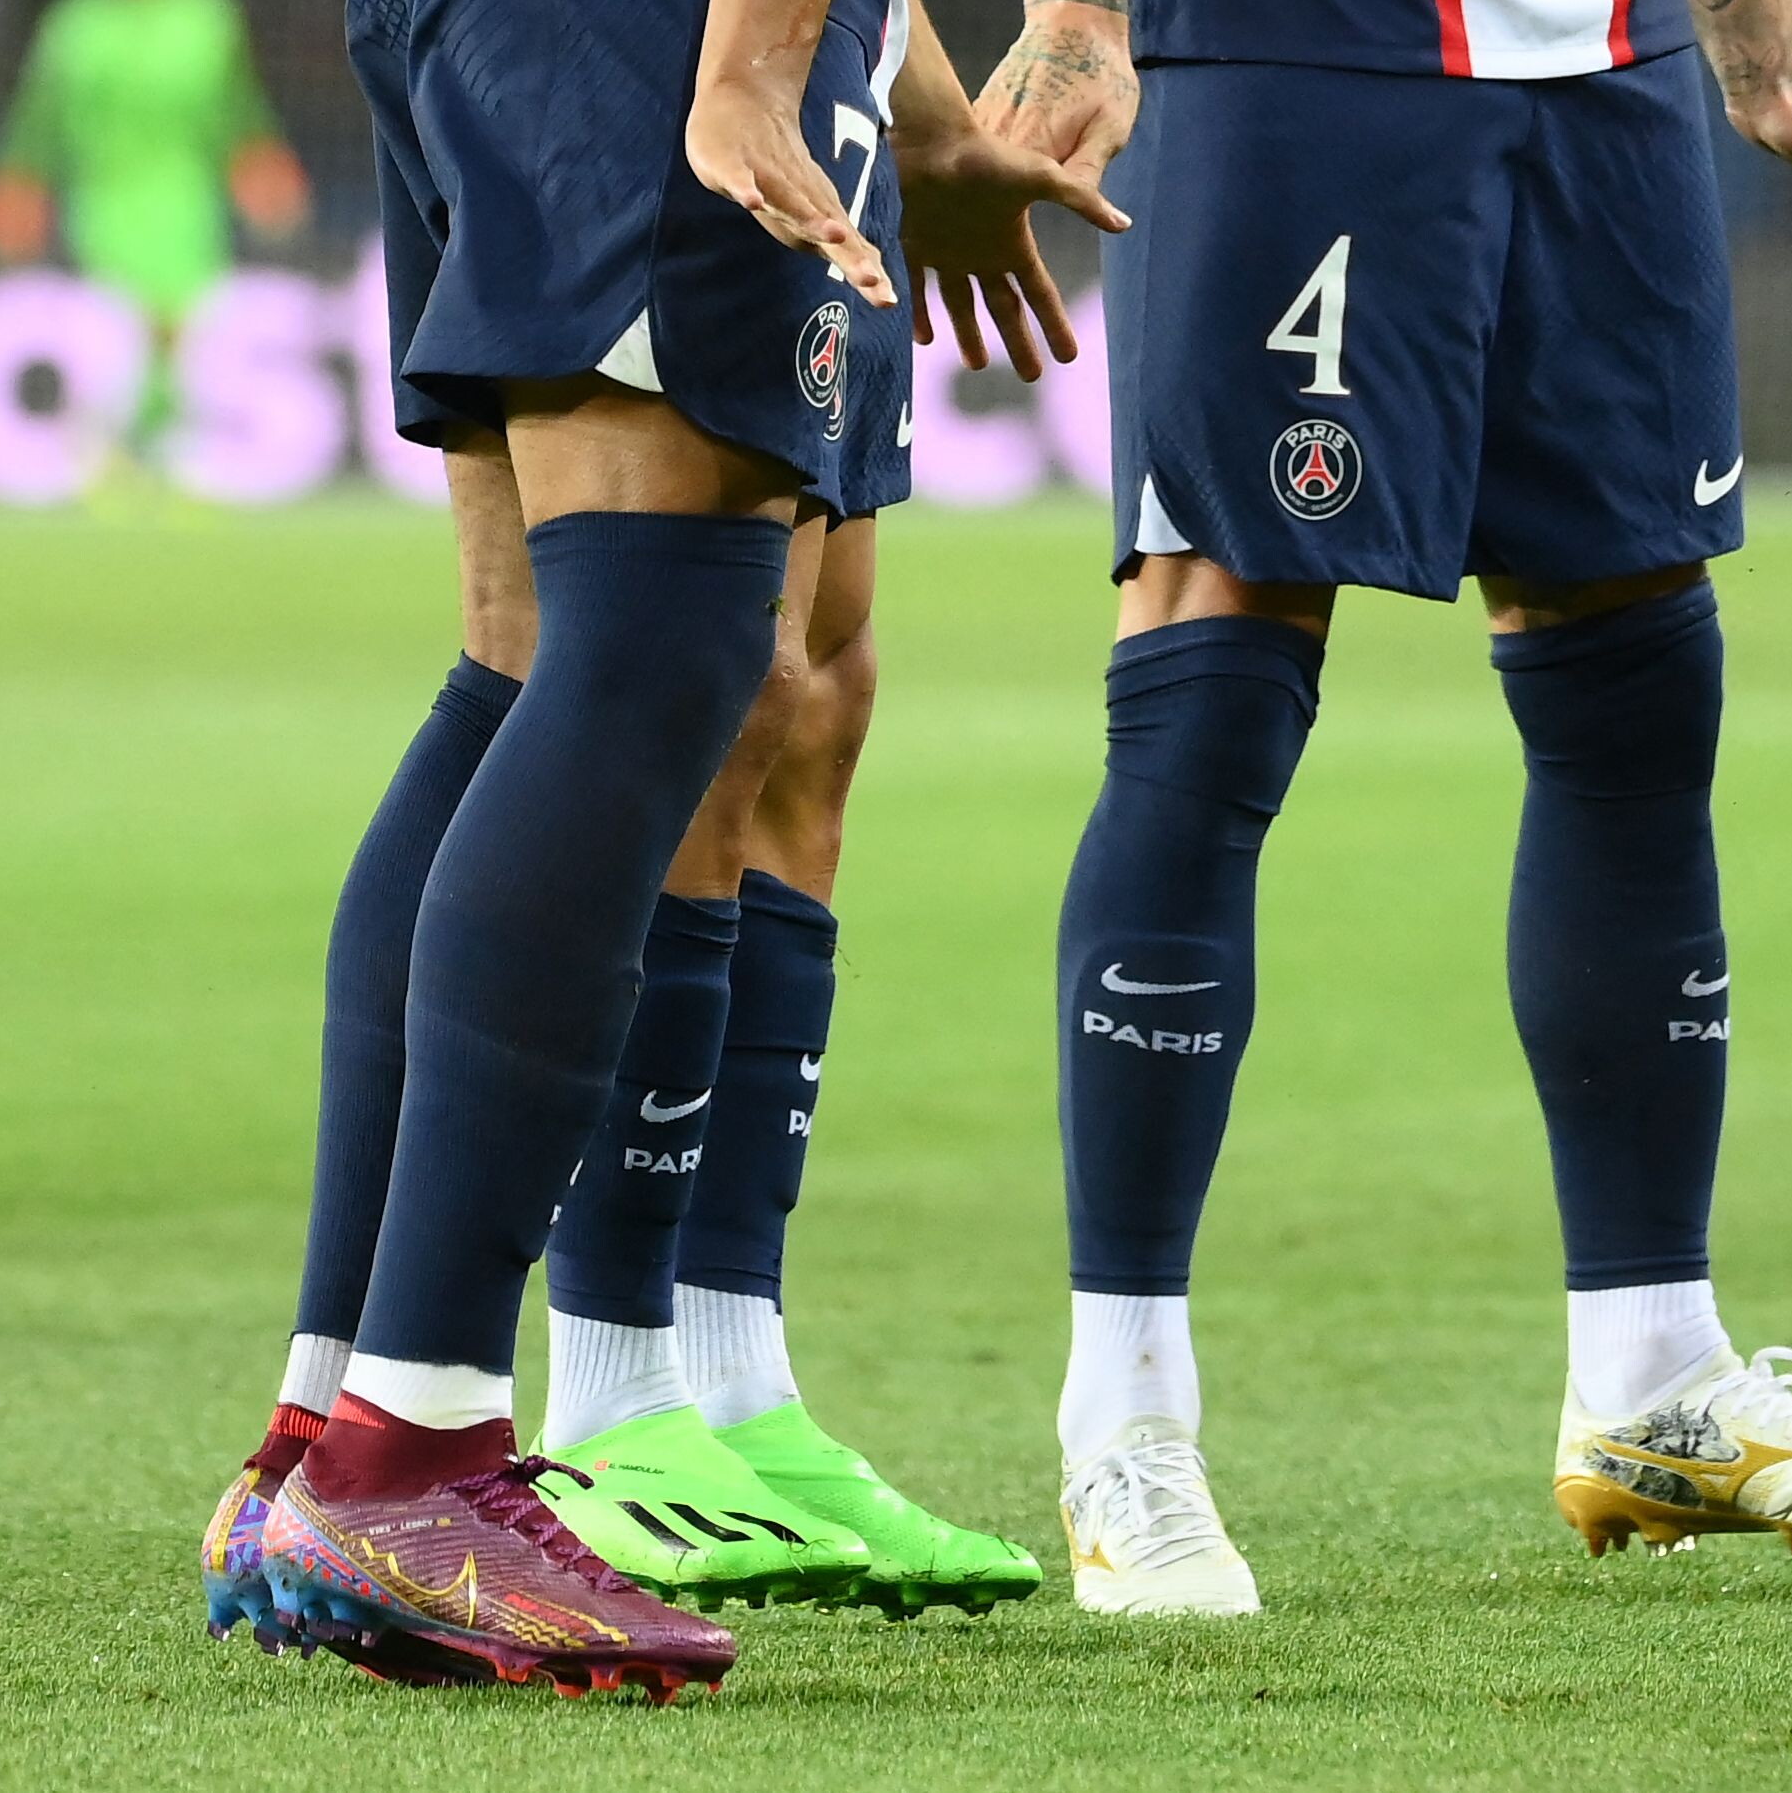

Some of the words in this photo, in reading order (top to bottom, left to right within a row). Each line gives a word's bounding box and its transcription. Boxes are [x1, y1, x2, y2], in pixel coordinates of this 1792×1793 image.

[826, 103, 878, 282] 7
[817, 306, 848, 339] PARIS
[1265, 234, 1351, 396] 4
[1285, 424, 1347, 450] PARIS
[1083, 1009, 1224, 1055] PARIS
